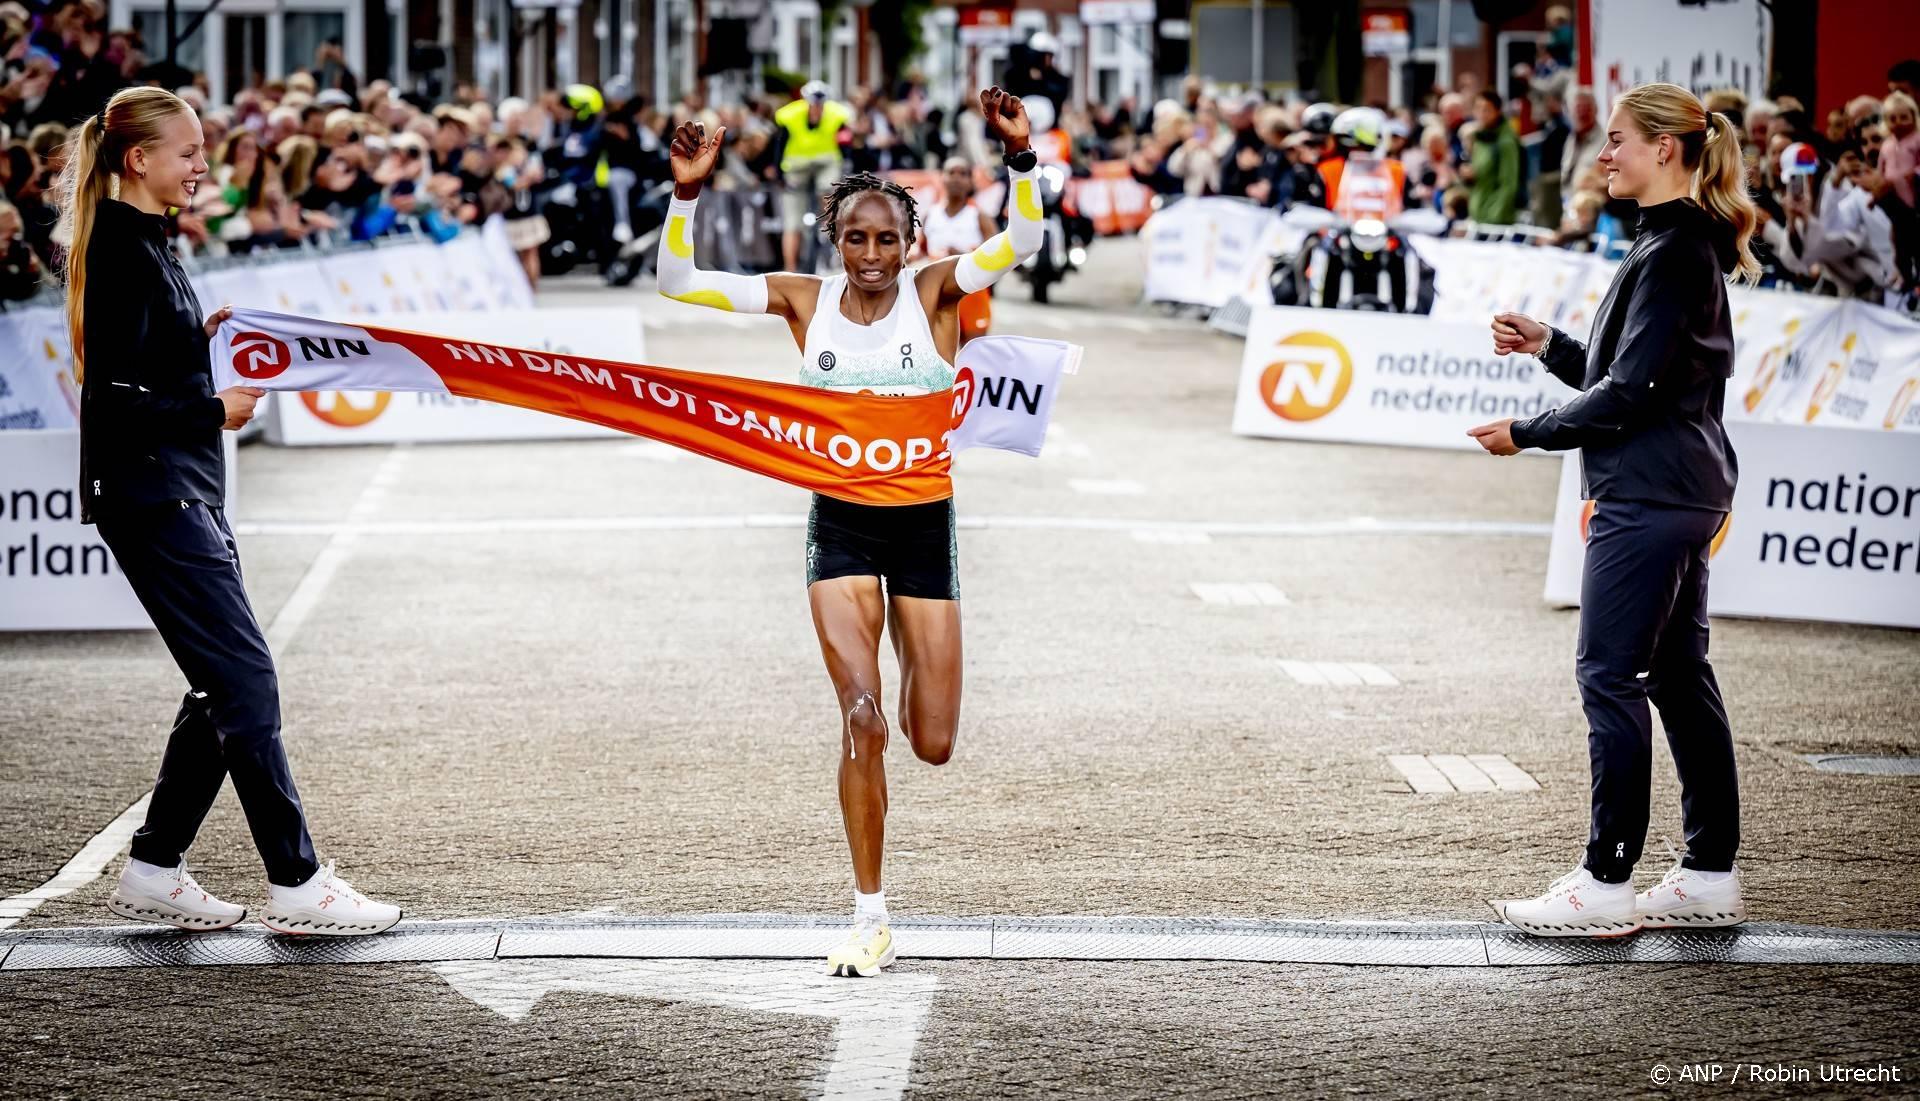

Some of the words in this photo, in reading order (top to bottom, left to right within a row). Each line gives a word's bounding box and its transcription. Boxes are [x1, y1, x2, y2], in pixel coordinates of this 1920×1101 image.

[297, 336, 370, 361] NN
[1376, 351, 1534, 383] nationale
[443, 343, 514, 367] NN
[518, 352, 616, 391] DAM
[621, 373, 697, 415] TOT
[707, 400, 933, 471] DAMLOOP
[977, 376, 1044, 416] NN
